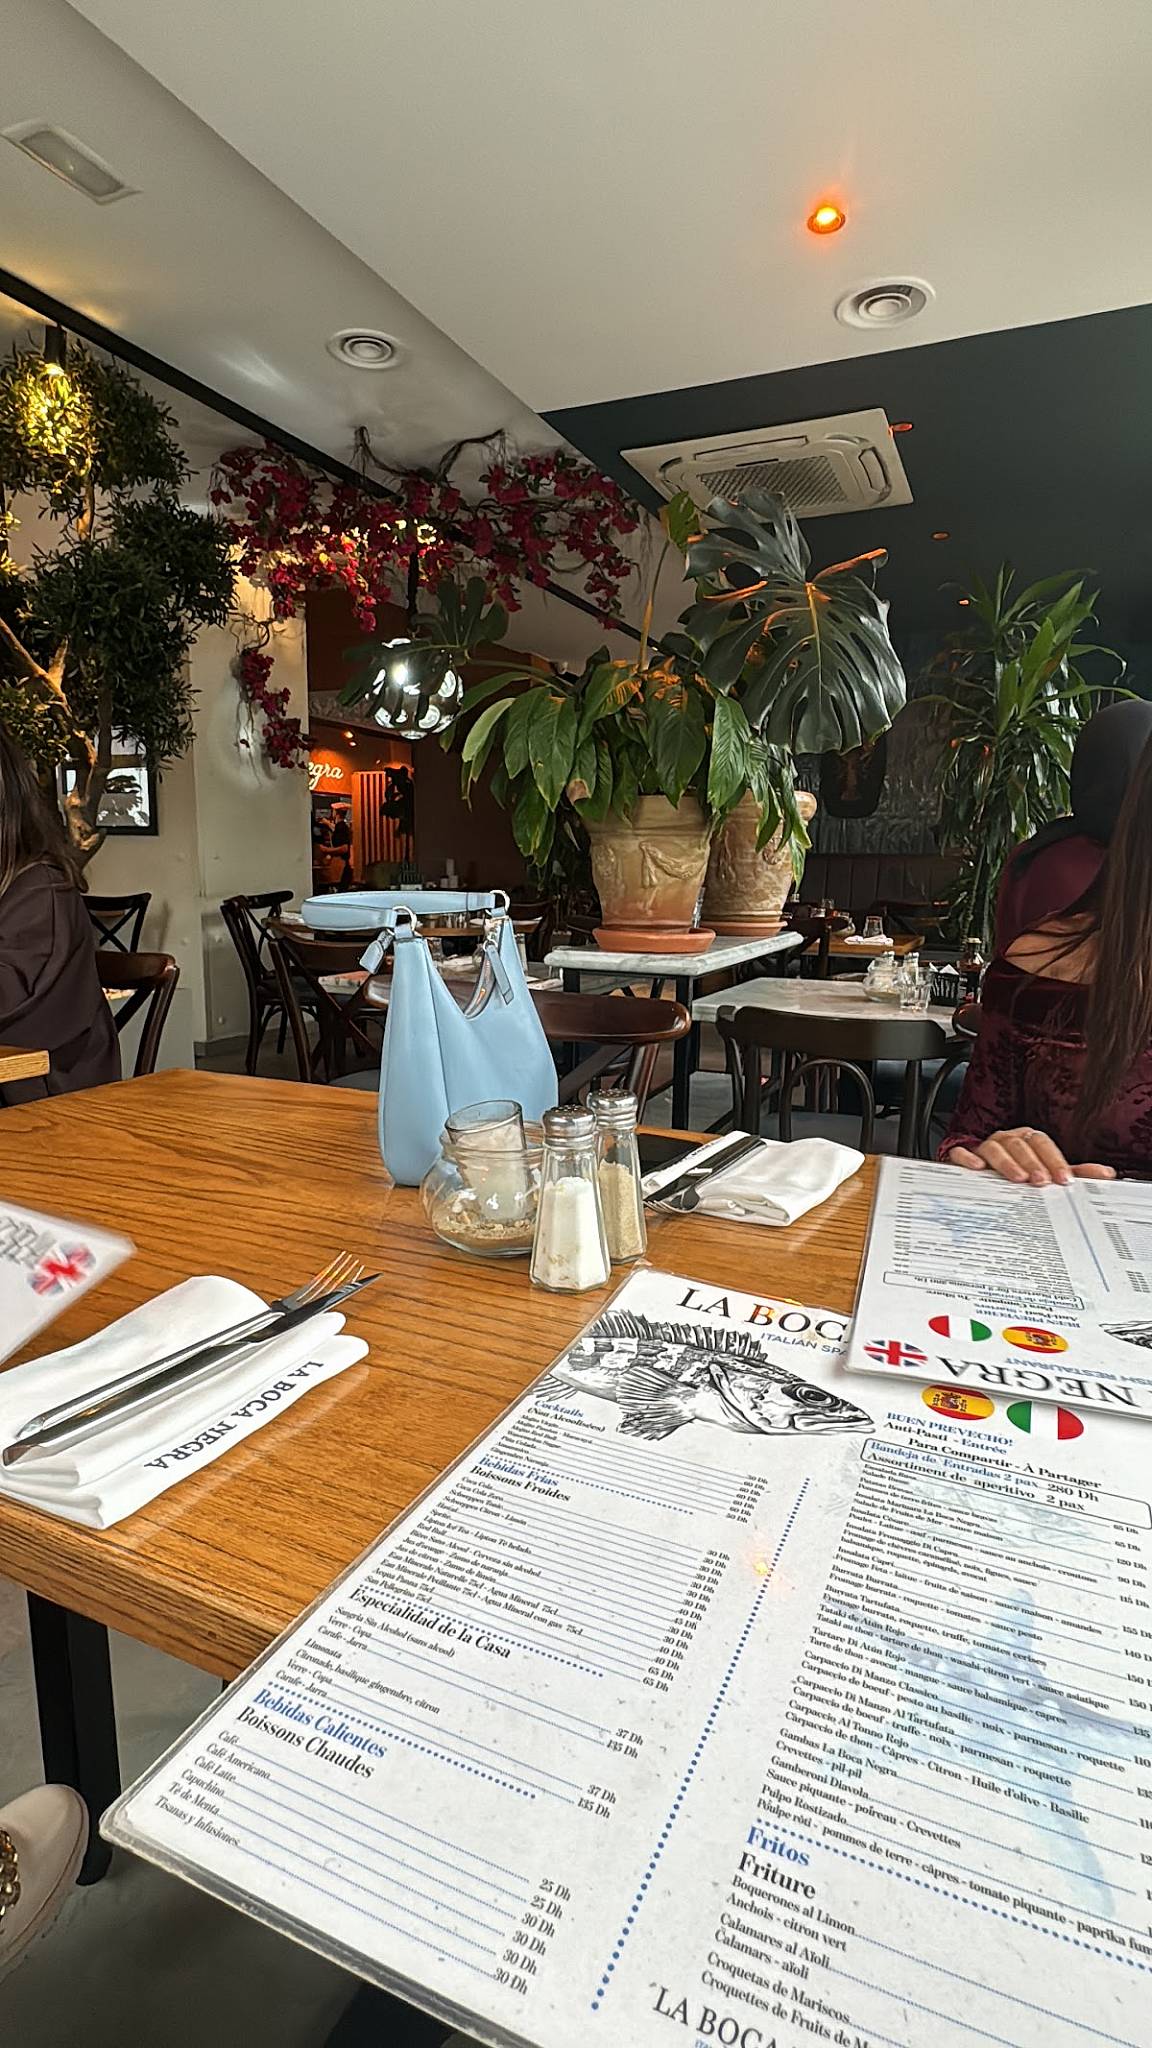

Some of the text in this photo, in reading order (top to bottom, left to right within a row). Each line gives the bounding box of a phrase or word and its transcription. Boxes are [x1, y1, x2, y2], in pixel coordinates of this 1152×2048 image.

[677, 1288, 729, 1317] LA
[743, 1303, 850, 1344] BOC
[761, 1333, 817, 1349] ITALIAN
[937, 1354, 1139, 1407] NEGRA
[144, 1362, 325, 1469] LA BOCA NEGRA
[535, 1401, 583, 1417] Cocktails
[887, 1413, 925, 1426] BUEN
[470, 1466, 570, 1501] Boissons Froides
[479, 1457, 525, 1476] Bebidas
[868, 1453, 1085, 1514] Assortiment de aperitivo 2 pax
[871, 1442, 918, 1459] Bandeja
[921, 1454, 937, 1464] de
[944, 1459, 1000, 1478] Entradas
[1003, 1473, 1012, 1482] 2
[1048, 1484, 1073, 1495] 280
[1079, 1490, 1098, 1501] Dh
[909, 1438, 937, 1451] Para
[942, 1447, 1012, 1467] Compartir
[1039, 1468, 1101, 1488] Partager
[305, 1638, 342, 1659] Limonata
[350, 1588, 510, 1658] Especialidad de la Casa
[813, 1626, 845, 1642] Tartare
[847, 1637, 859, 1648] Di
[885, 1649, 906, 1662] Rojo
[318, 1626, 638, 1758] Carafe Jarra 135 Dh
[329, 1616, 643, 1745] Verre Copa 37 Dh
[334, 1664, 370, 1684] basilique
[415, 1700, 440, 1714] citron
[237, 1707, 374, 1777] Boissons Chaudes
[253, 1689, 387, 1757] Bebidas Calientes
[276, 1670, 610, 1818] Carafe Jarra 135 Dh
[287, 1659, 616, 1804] Verre Copa 37 Dh
[771, 1756, 870, 1799] Gamberoni Diavola
[776, 1741, 862, 1778] Crevettes pil-pil
[780, 1728, 897, 1777] Gambas La Boca Negra
[207, 1743, 562, 1919] Café Americano 25 Dh
[219, 1731, 570, 1901] Café 25 Dh
[762, 1784, 847, 1825] Pulpo Rostizado
[766, 1769, 797, 1787] Sauce
[799, 1783, 846, 1805] piquante
[907, 1821, 960, 1848] Crevettes
[181, 1769, 546, 1955] Capuchino 30 Dh
[195, 1756, 555, 1937] Café Latte 30 Dh
[747, 1826, 809, 1865] Fritos
[155, 1796, 527, 1995] Tisanas y Infusiones 30 Dh
[169, 1782, 536, 1975] Té de Menta 30 Dh
[732, 1875, 800, 1912] Boquerones
[801, 1905, 815, 1919] al
[739, 1852, 815, 1899] Friture
[715, 1929, 771, 1963] Calamars
[721, 1913, 782, 1948] Calamares
[784, 1941, 798, 1956] al
[727, 1893, 846, 1952] Anchois citron vert
[654, 1987, 688, 2025] LA
[702, 1971, 851, 2048] Croquettes de Fruits de
[708, 1952, 850, 2024] Croquetas de Mariscos
